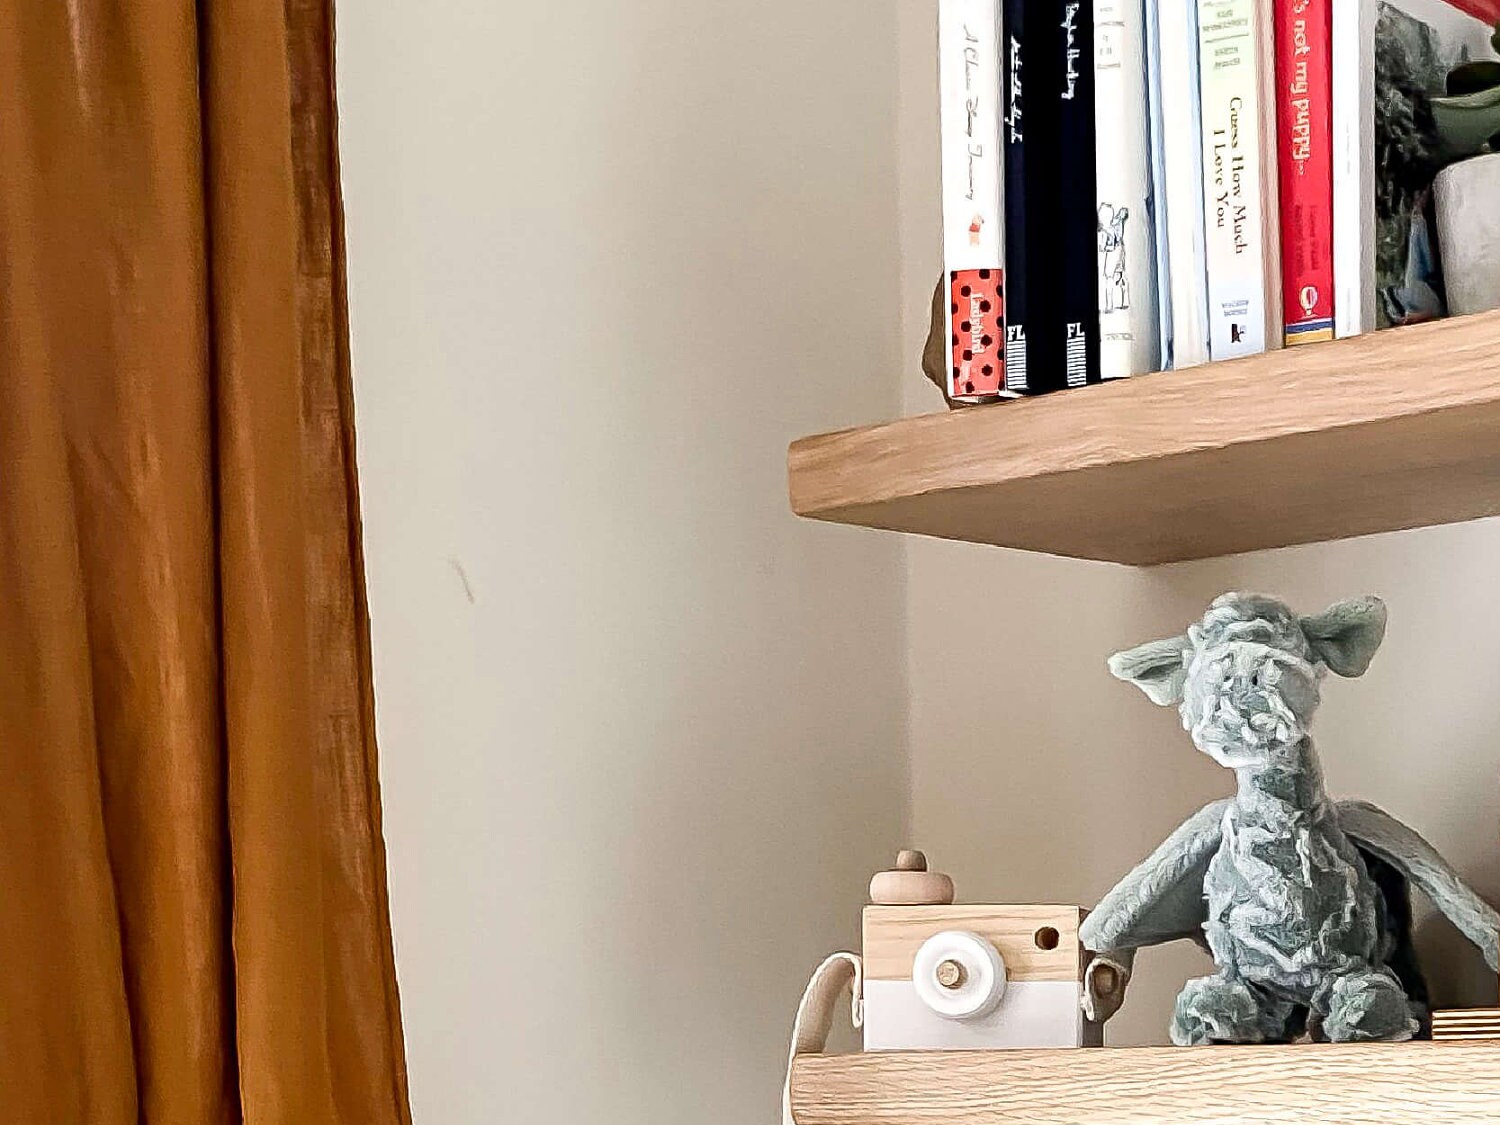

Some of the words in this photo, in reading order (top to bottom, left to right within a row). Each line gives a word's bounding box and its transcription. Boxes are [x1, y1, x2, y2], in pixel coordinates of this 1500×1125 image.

[1294, 20, 1311, 55] not
[1290, 62, 1309, 94] my
[1230, 96, 1243, 149] Guess
[1213, 144, 1226, 185] Love
[1231, 156, 1244, 198] How
[1215, 191, 1229, 228] You
[1232, 205, 1248, 254] Much
[969, 293, 985, 354] Ladybird
[1006, 325, 1026, 340] FL
[1066, 322, 1085, 338] FL
